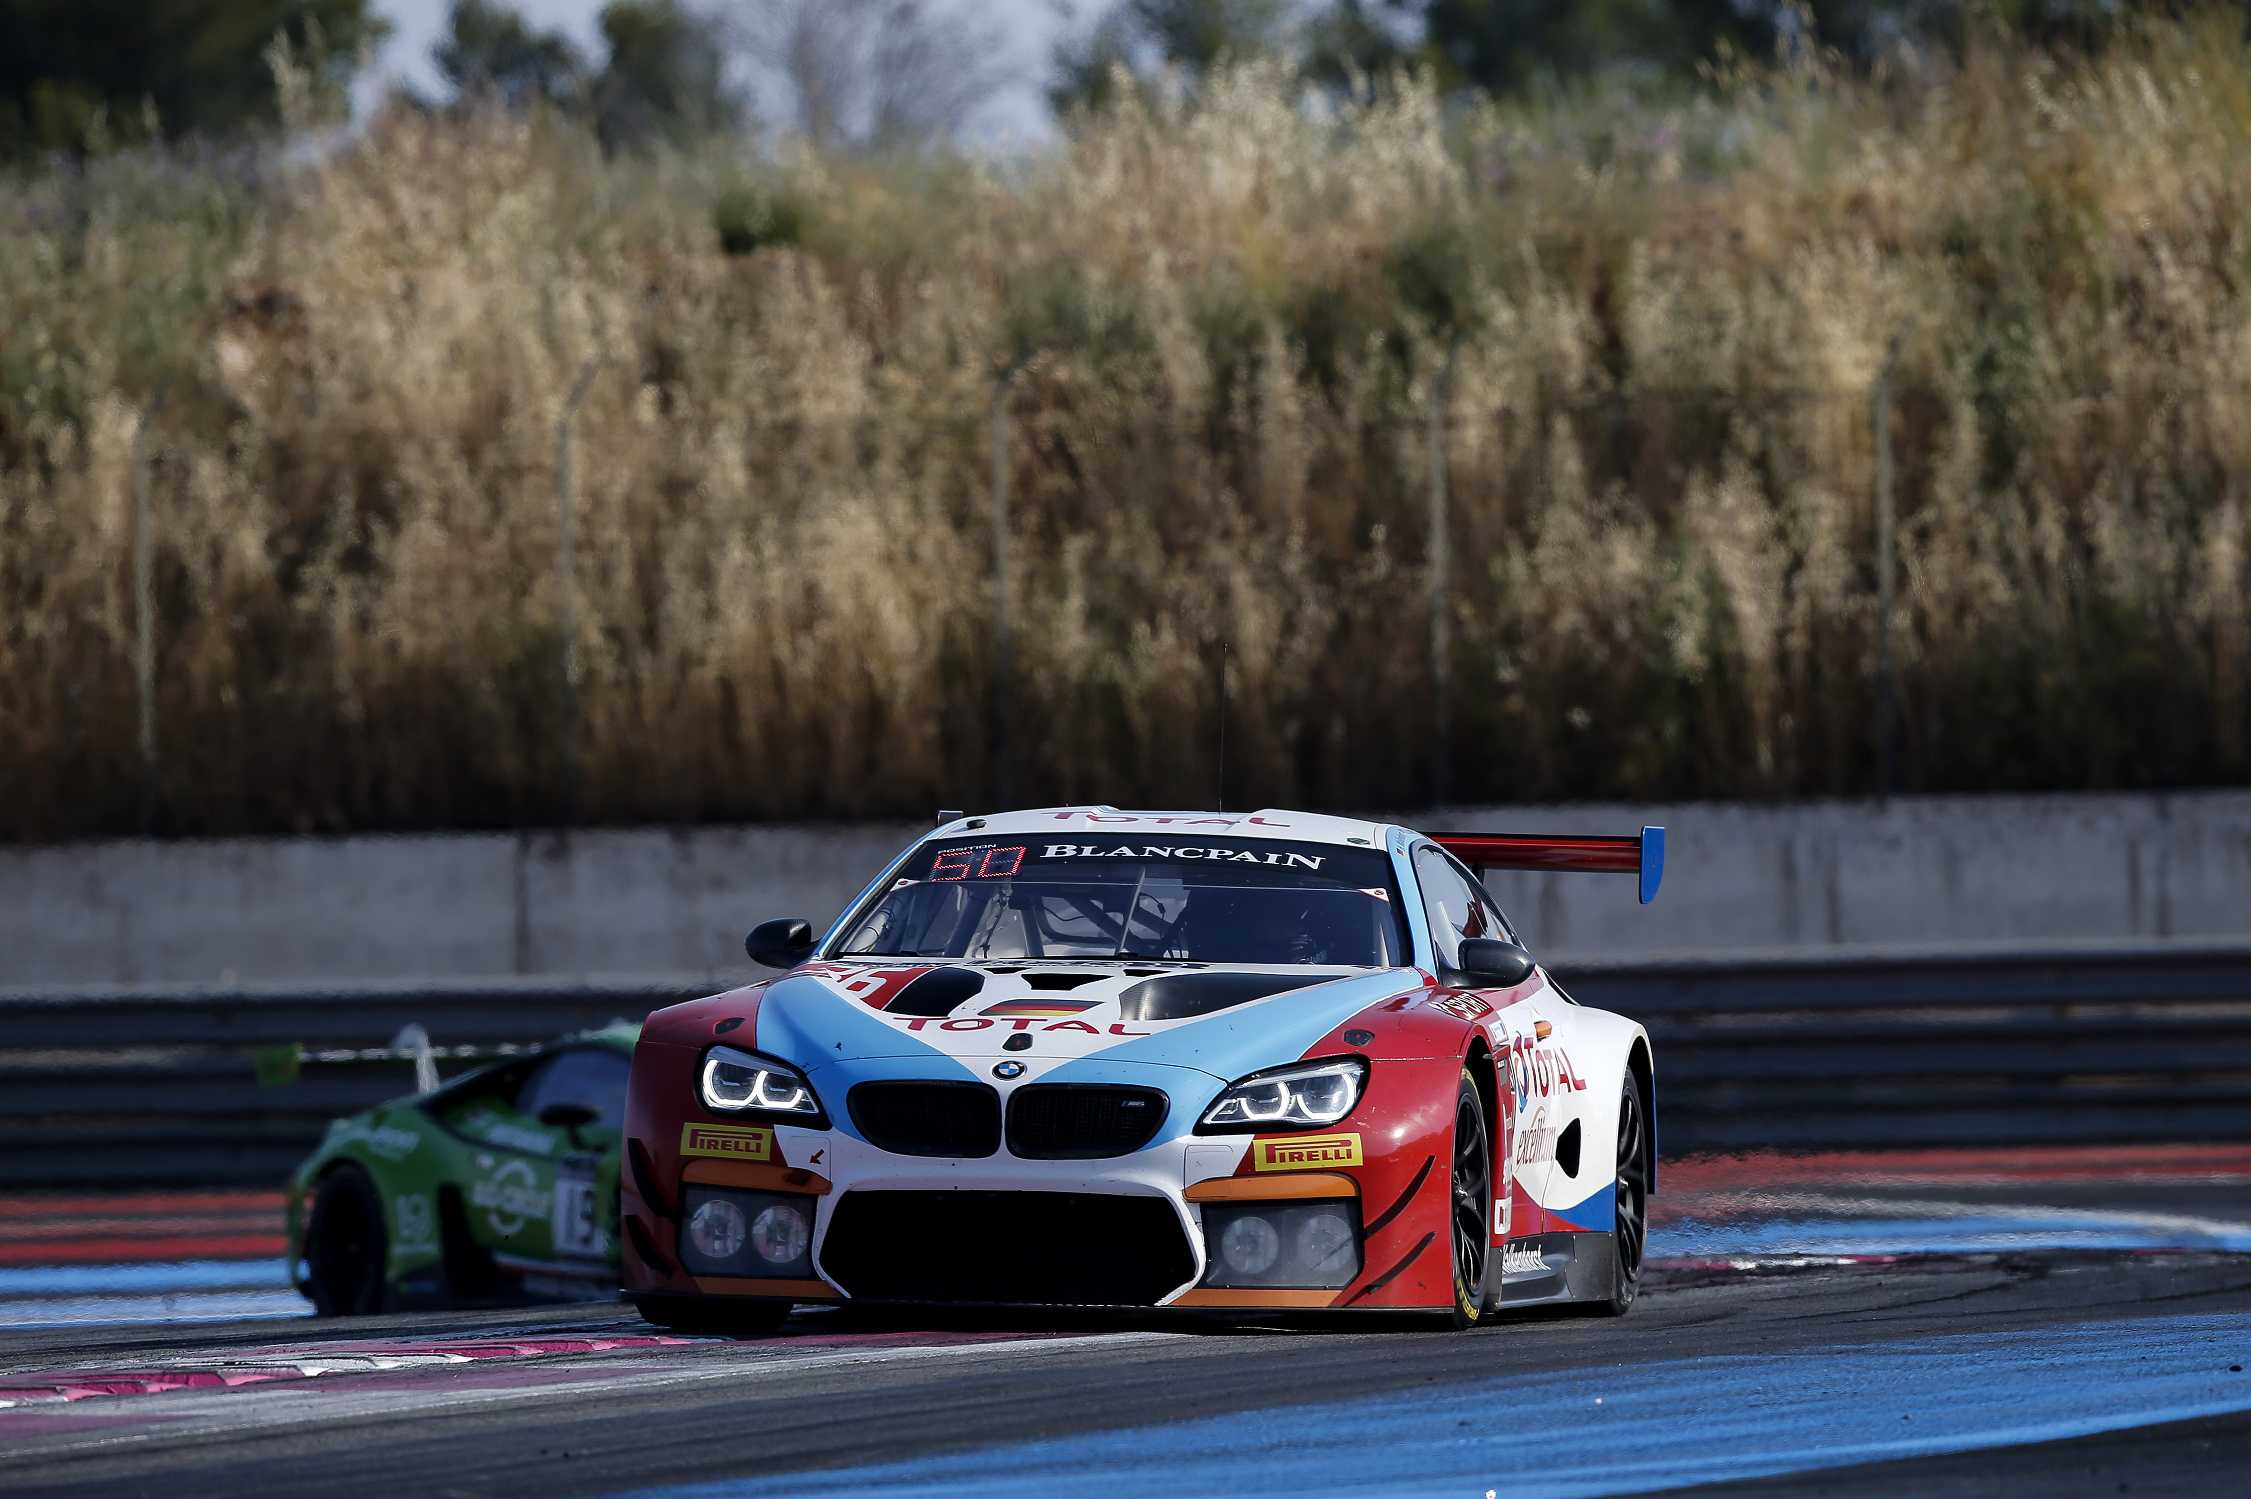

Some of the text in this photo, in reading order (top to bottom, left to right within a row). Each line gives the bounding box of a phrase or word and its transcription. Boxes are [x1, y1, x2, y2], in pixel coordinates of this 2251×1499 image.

[1040, 811, 1291, 828] TOTAL
[1039, 843, 1326, 870] BLANCPAIN
[893, 1016, 1152, 1036] TOTAL
[1523, 1036, 1588, 1098] TOTAL
[689, 1129, 764, 1154] PIRELLI
[1264, 1139, 1353, 1164] PIRELLI
